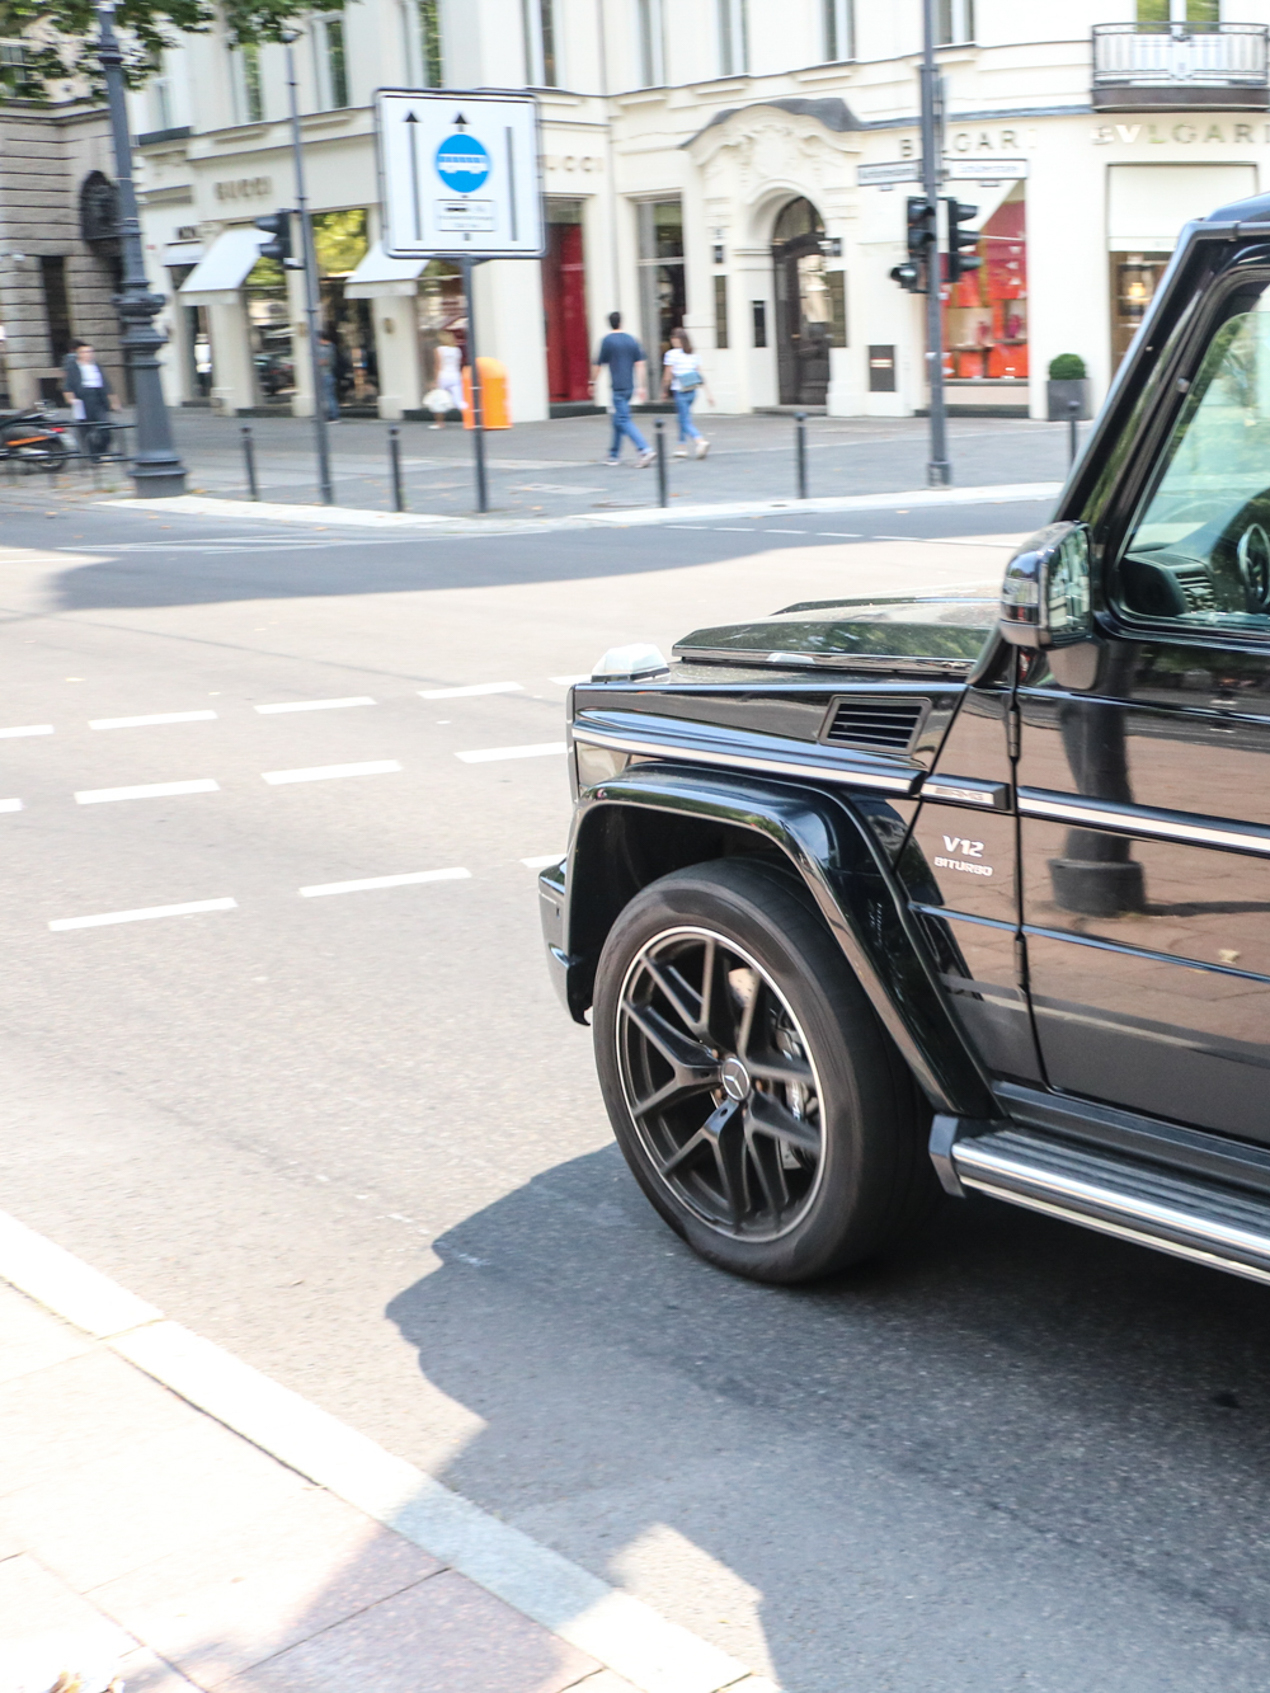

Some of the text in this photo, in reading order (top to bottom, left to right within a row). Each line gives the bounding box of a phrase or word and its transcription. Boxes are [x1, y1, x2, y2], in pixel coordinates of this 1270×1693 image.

[901, 129, 1037, 157] BGARI
[942, 835, 985, 858] V12
[934, 856, 994, 877] BITURBO
